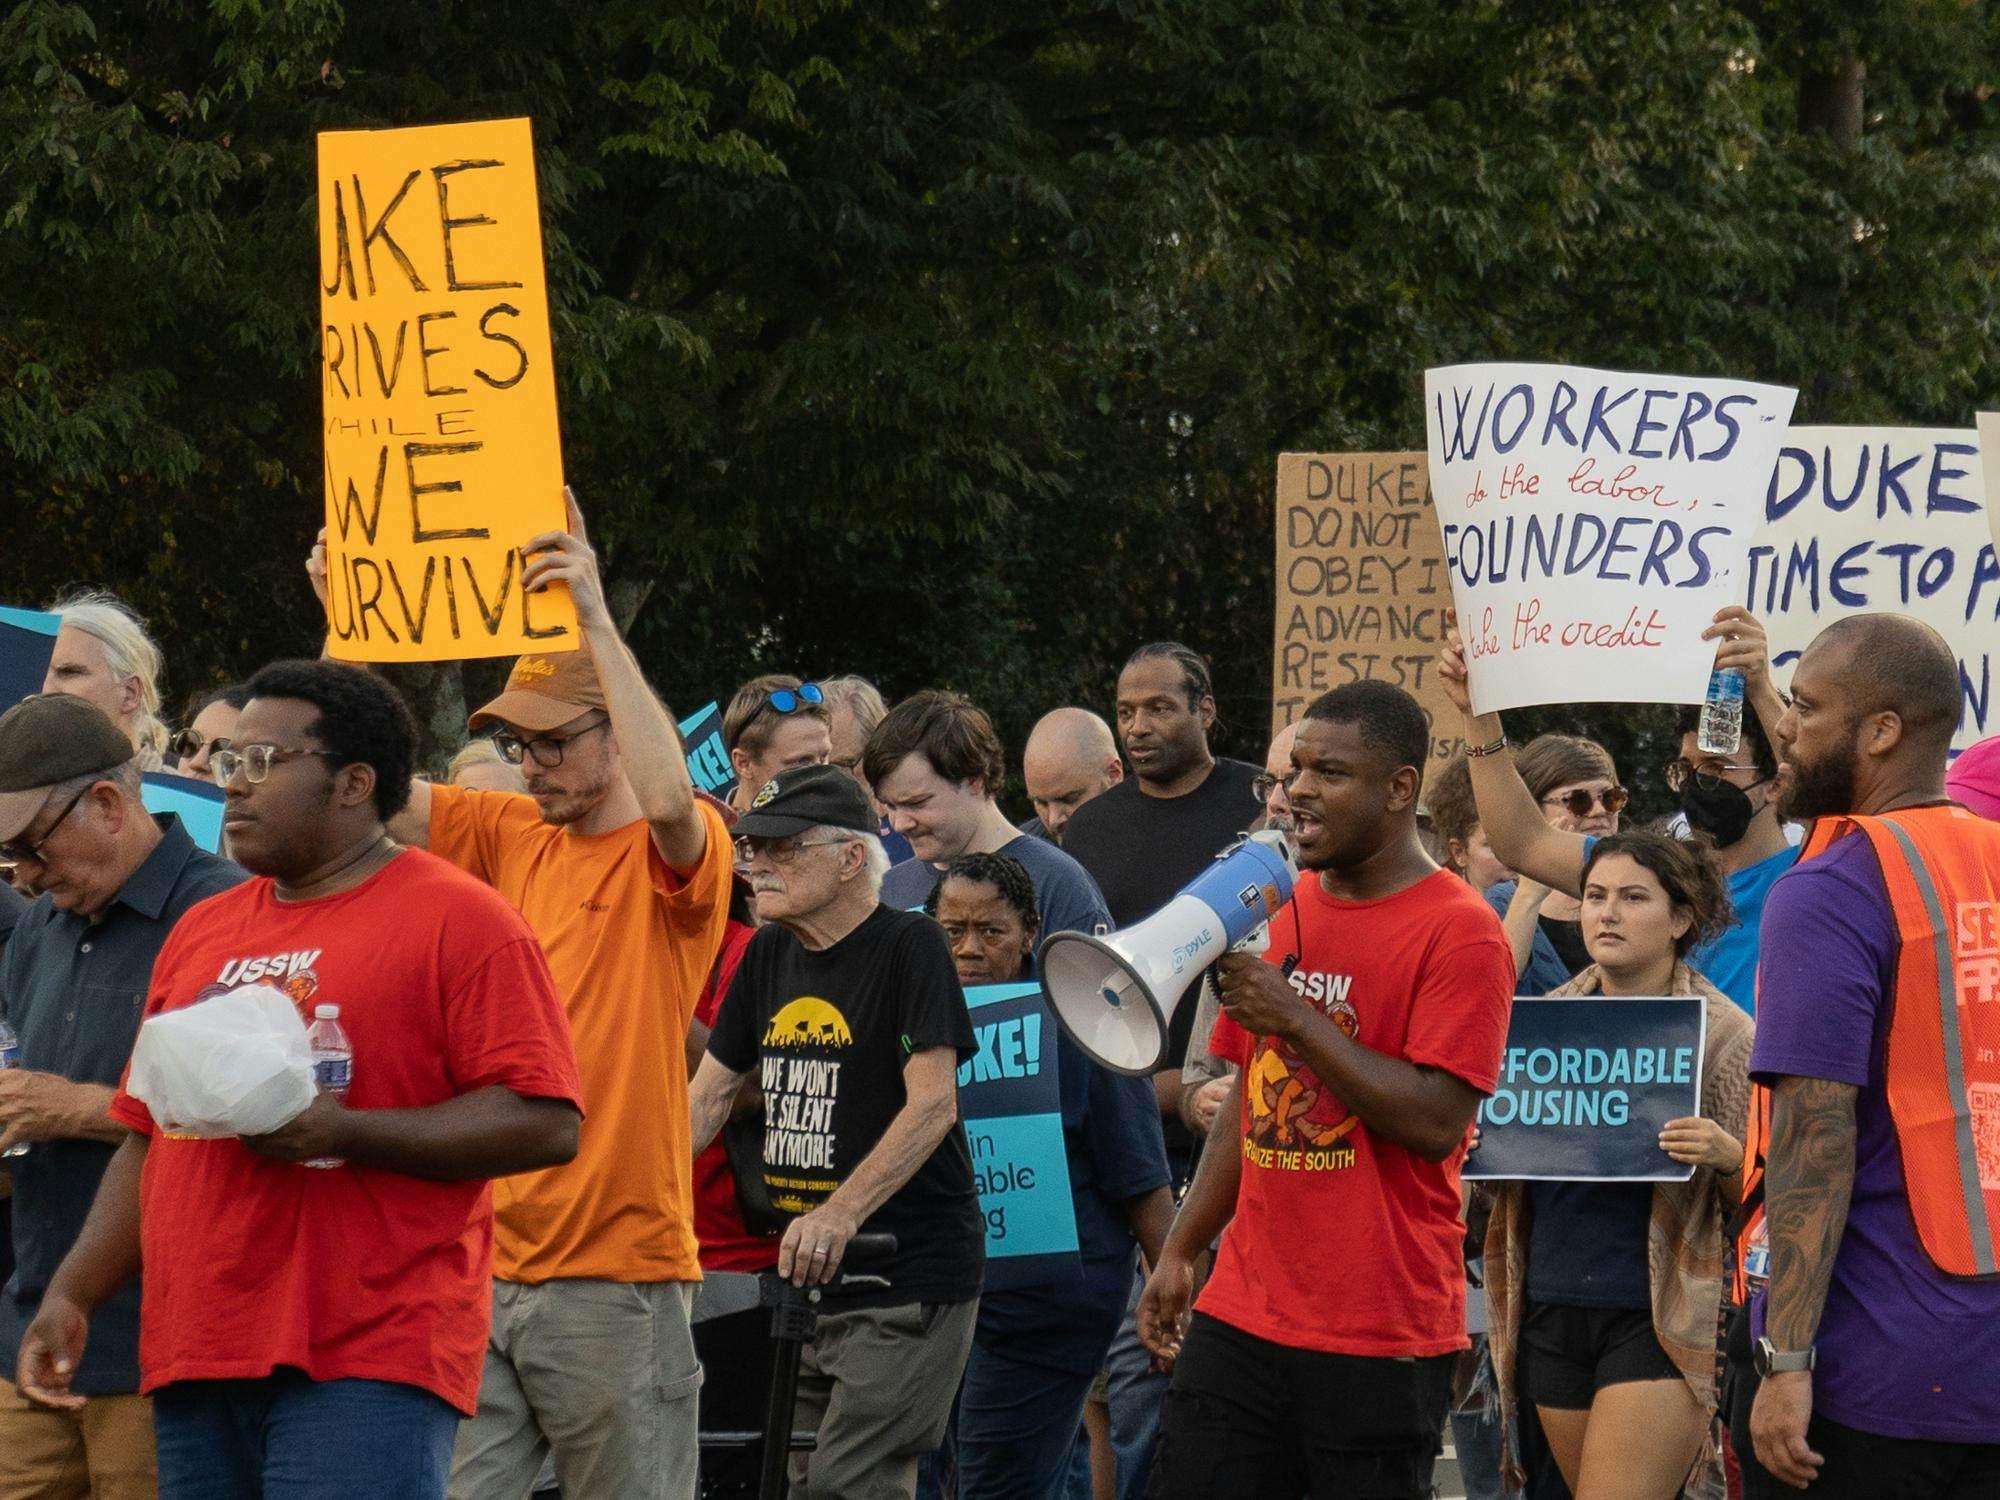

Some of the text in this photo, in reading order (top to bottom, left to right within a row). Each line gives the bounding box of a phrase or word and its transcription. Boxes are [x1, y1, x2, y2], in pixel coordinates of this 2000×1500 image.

[324, 303, 528, 398] RIVES
[1437, 380, 1757, 465] WORKERS
[326, 441, 490, 546] WE
[1465, 470, 1488, 508] do
[1500, 463, 1540, 499] the
[1765, 443, 1983, 524] DUKE
[1288, 505, 1421, 549] DO NOT
[1444, 512, 1732, 588] FOUNDERS
[328, 546, 569, 644] URVIVE
[1287, 555, 1412, 597] OBEY
[1747, 536, 1875, 615] TIME
[1876, 544, 1955, 605] TO
[1512, 598, 1552, 650] the
[1561, 606, 1666, 648] credit
[1282, 641, 1435, 691] RESIST
[217, 949, 323, 987] USSW
[1288, 970, 1352, 1006] SSW
[762, 1057, 840, 1097] WE WON'T
[778, 1094, 836, 1133] SILENT
[968, 1130, 995, 1159] in
[1277, 1149, 1302, 1171] THE
[1305, 1149, 1355, 1171] SOUTH
